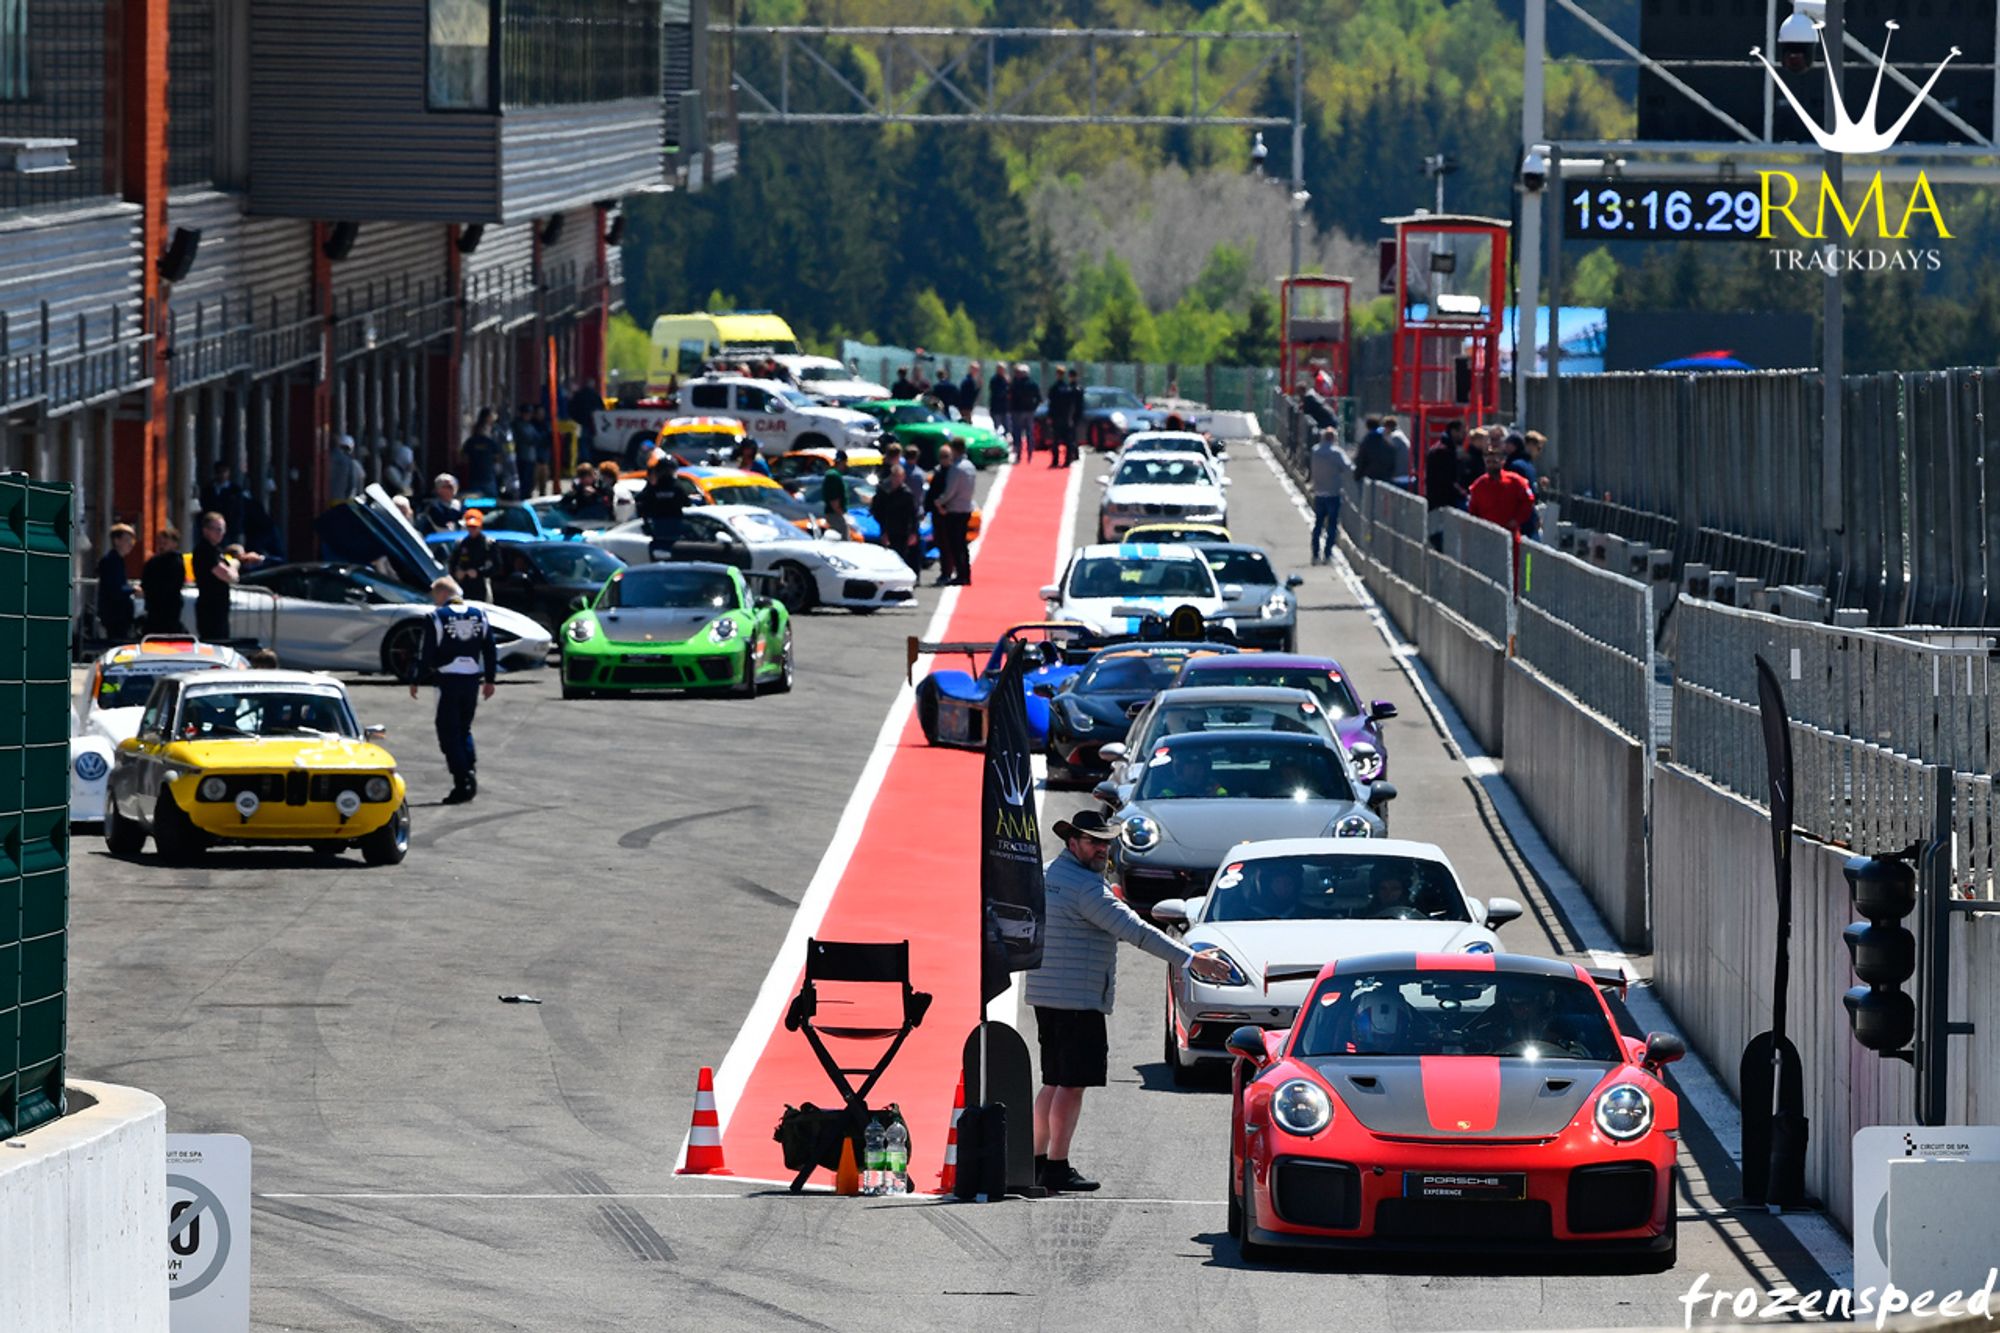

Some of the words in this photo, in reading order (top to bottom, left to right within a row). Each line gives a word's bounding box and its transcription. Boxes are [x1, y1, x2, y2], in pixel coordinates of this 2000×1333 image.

[1573, 189, 1760, 232] 13:16.29
[754, 419, 787, 432] CAR
[1423, 1176, 1499, 1185] PORSCHE
[1423, 1188, 1462, 1196] EXPERIENCE
